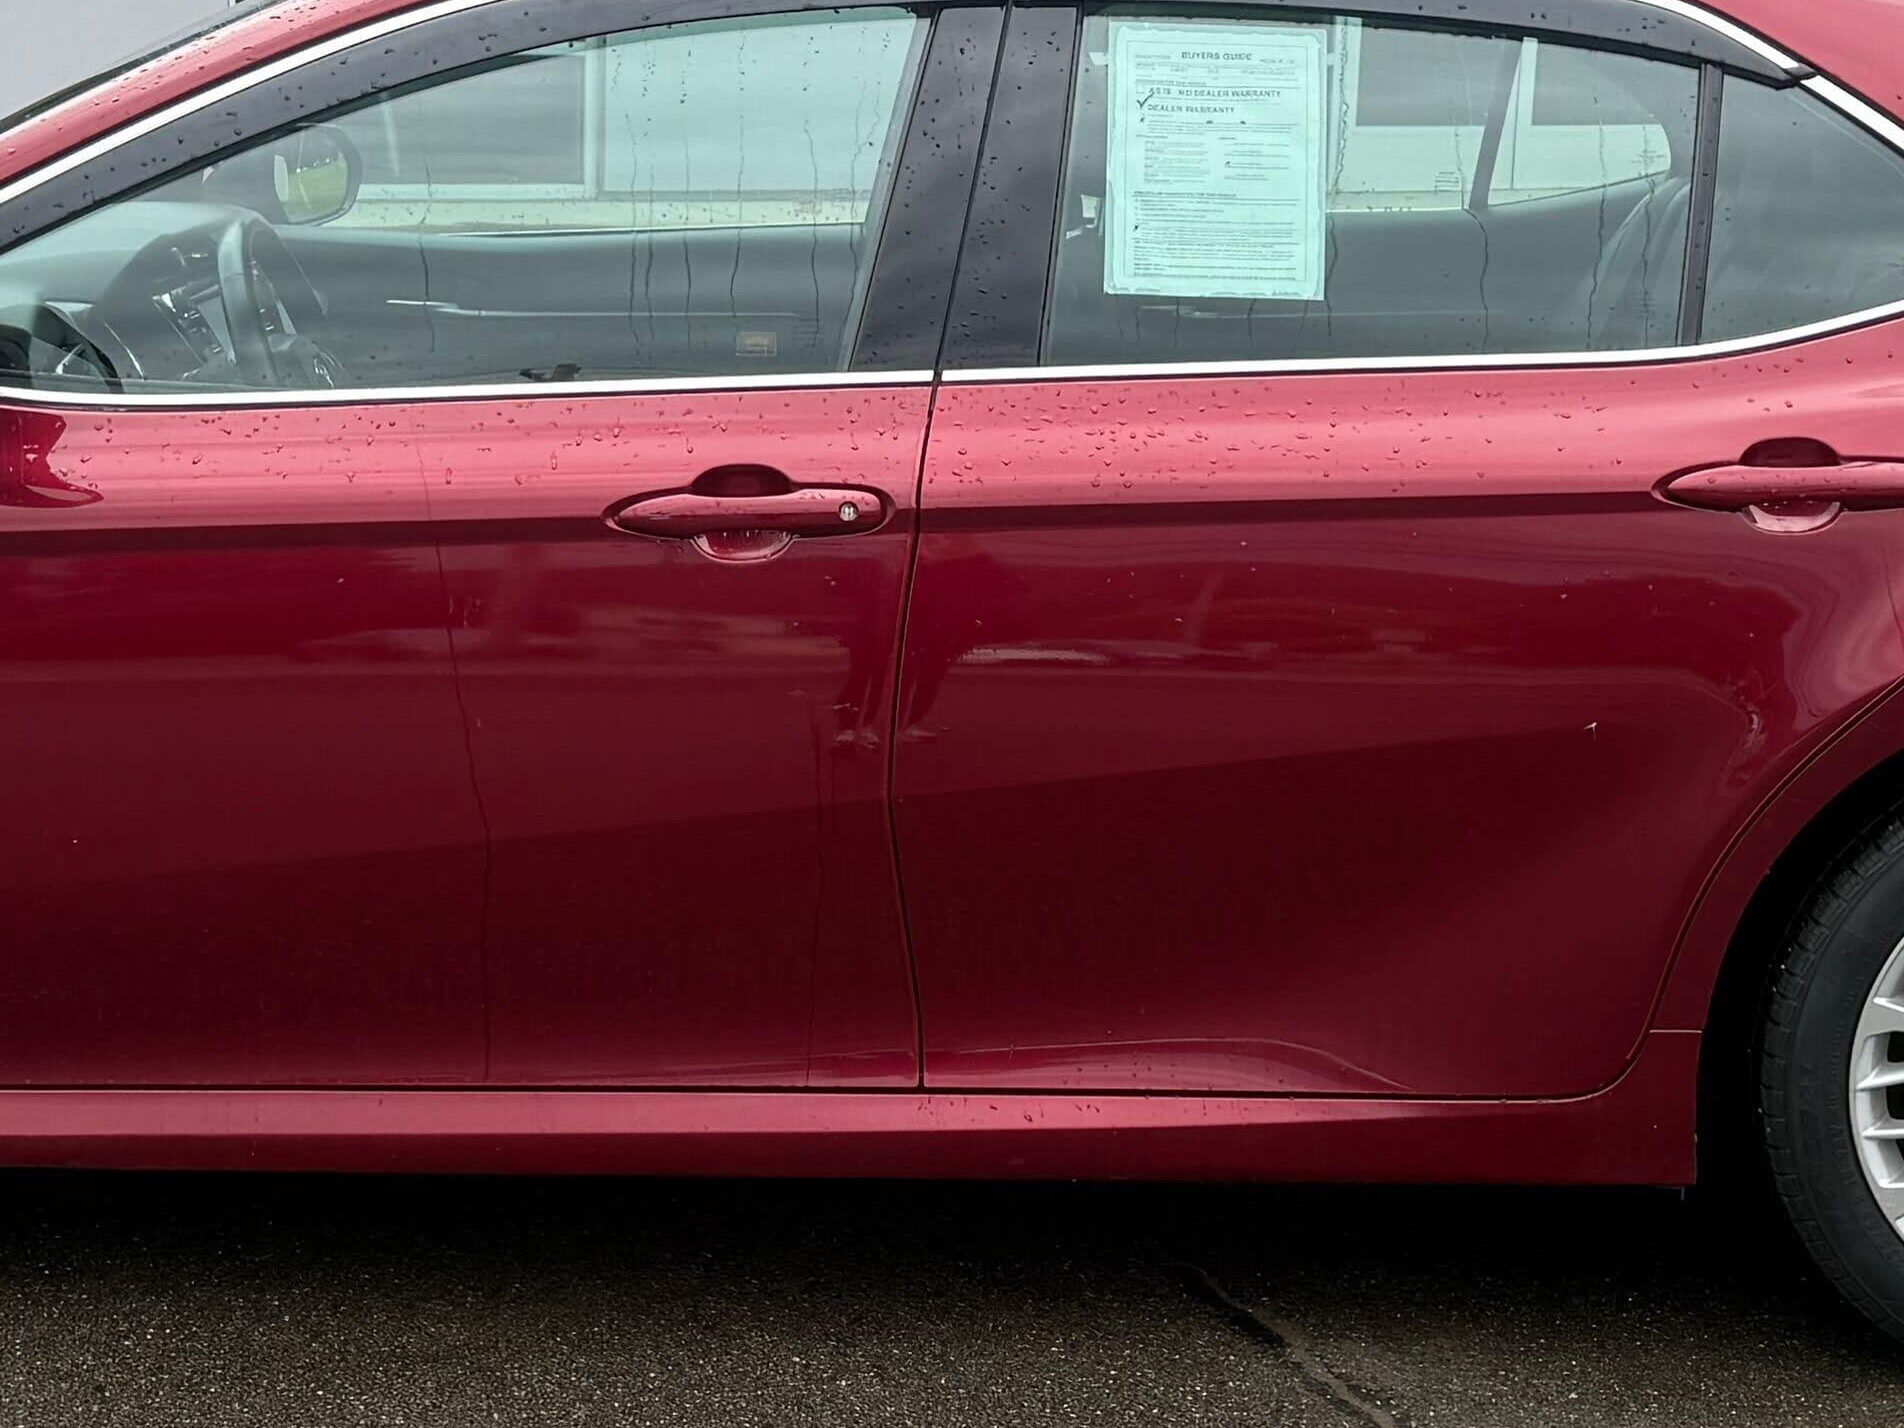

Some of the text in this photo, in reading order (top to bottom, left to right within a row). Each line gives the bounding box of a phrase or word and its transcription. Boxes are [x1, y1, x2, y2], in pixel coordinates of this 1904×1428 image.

[1180, 51, 1221, 61] BUYERS
[1222, 52, 1253, 62] GUIDE
[1231, 90, 1282, 99] WARRANTY
